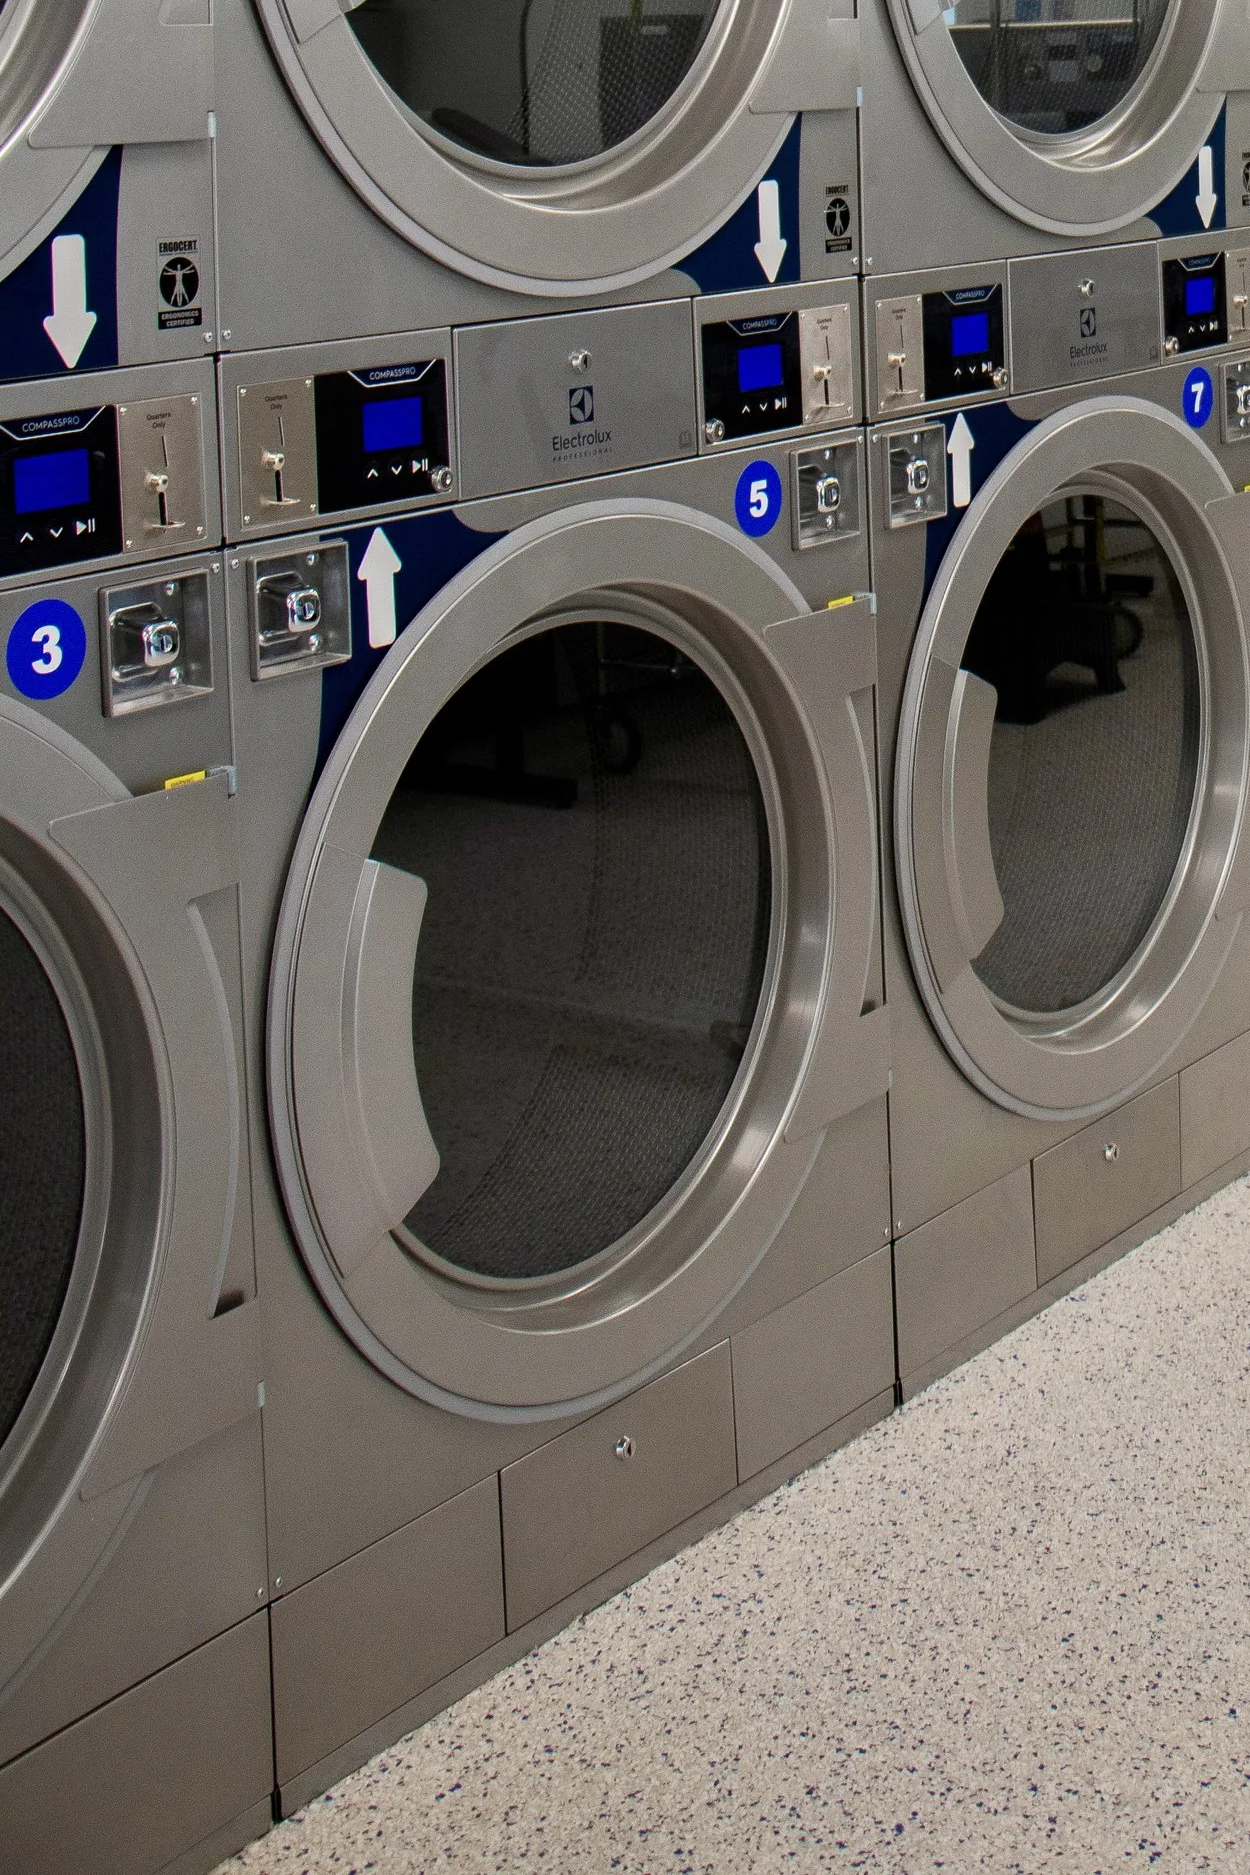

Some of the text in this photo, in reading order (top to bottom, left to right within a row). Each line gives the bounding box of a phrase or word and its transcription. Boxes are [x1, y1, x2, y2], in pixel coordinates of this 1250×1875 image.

[159, 240, 198, 253] ERGOCERT
[1069, 342, 1107, 358] Electrolux
[369, 367, 416, 381] COMPASSPRO
[1191, 381, 1204, 413] 7
[21, 415, 80, 433] COMPASSPRO
[552, 428, 612, 451] Electrolux
[749, 479, 768, 518] 5
[31, 625, 63, 675] 3
